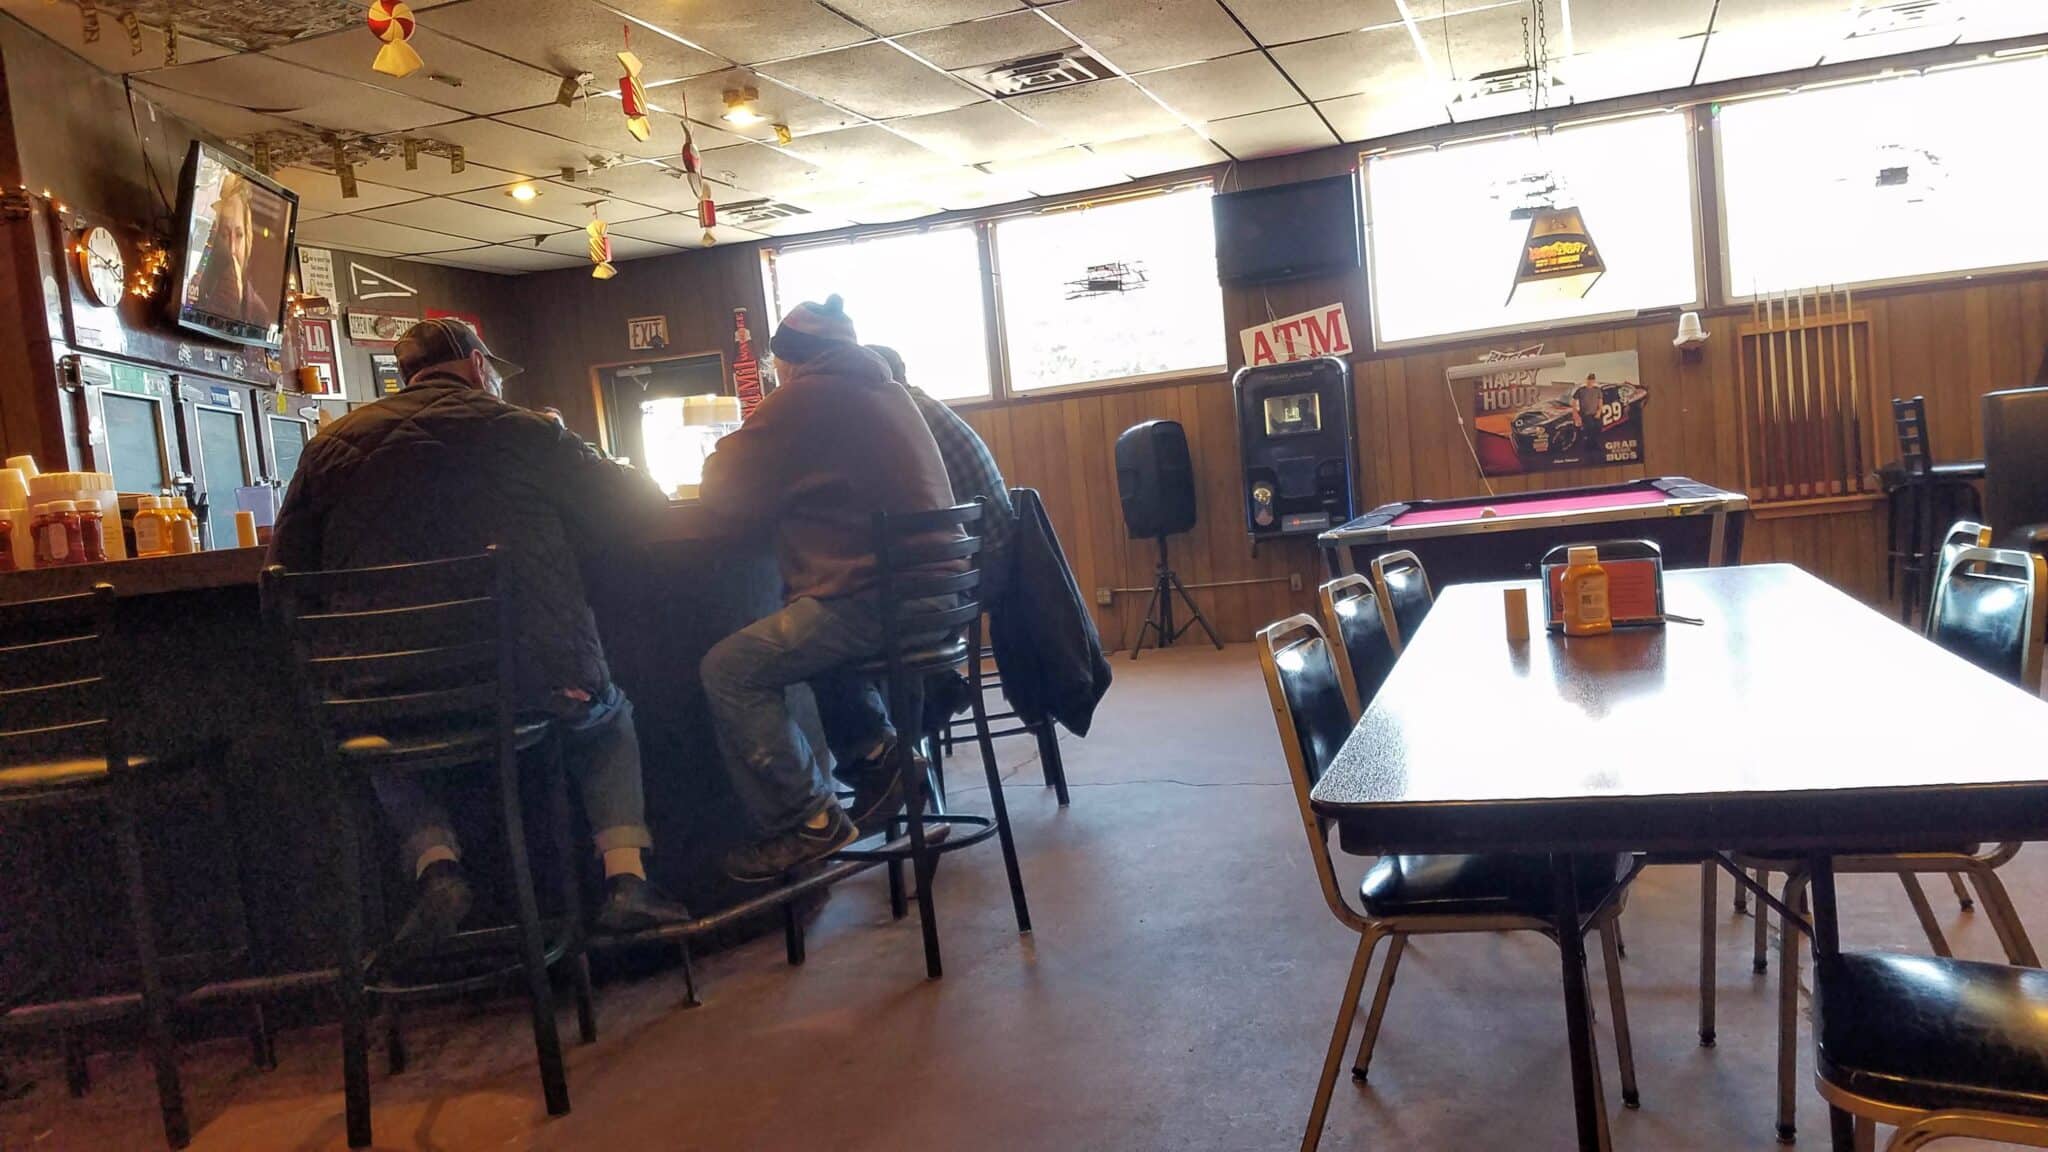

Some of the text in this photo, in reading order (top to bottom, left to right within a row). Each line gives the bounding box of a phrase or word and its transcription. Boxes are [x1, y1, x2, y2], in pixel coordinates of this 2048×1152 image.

[632, 322, 662, 347] EXIT
[1253, 308, 1349, 366] ATM
[1482, 369, 1538, 389] HAPPY
[1483, 386, 1540, 410] HOUR
[1602, 402, 1622, 426] 29
[1605, 440, 1637, 449] GRAB
[1606, 452, 1637, 462] BUDS
